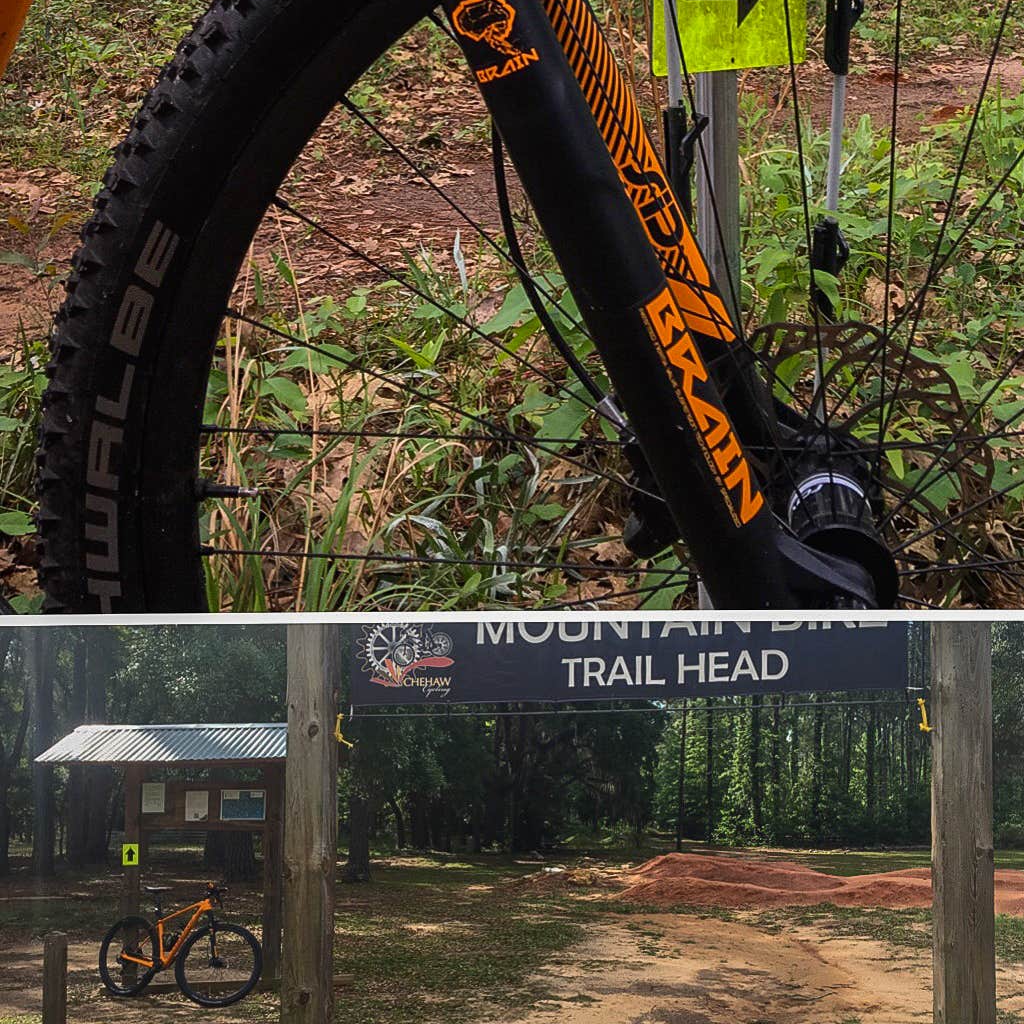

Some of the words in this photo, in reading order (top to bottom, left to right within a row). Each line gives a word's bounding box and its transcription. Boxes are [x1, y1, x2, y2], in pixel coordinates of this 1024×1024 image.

[475, 47, 540, 83] BRAIN
[646, 287, 764, 525] BRAIN
[403, 677, 451, 686] CHEHAW
[561, 655, 665, 687] TRAIL
[677, 649, 789, 684] HEAD
